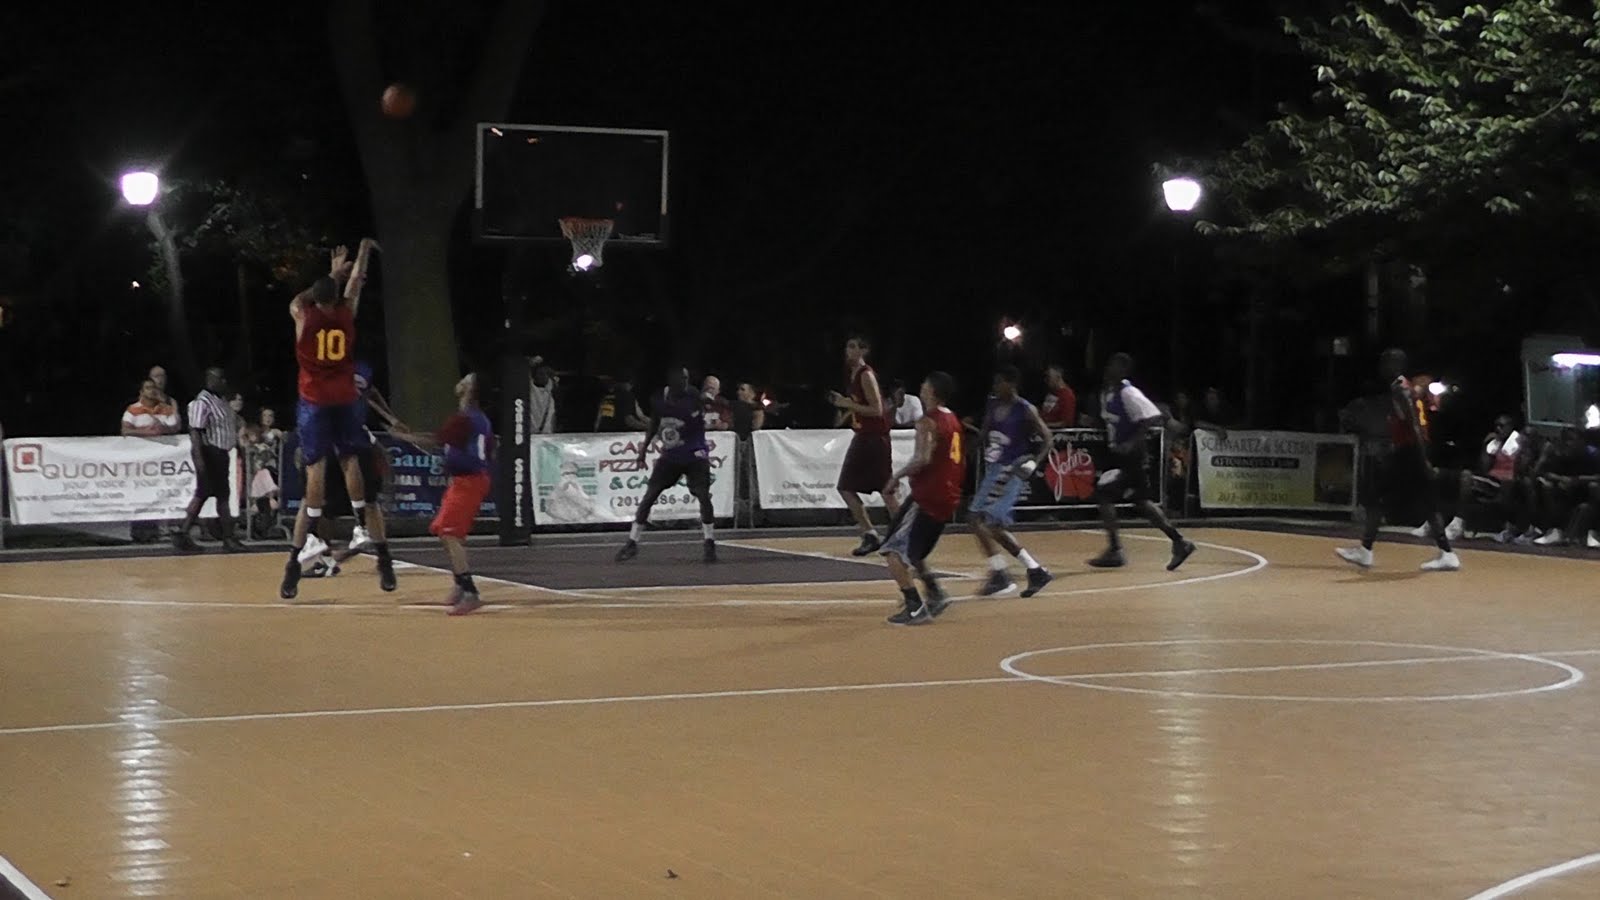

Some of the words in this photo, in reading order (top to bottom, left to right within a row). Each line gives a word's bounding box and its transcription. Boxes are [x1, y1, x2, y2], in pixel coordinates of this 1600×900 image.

[315, 328, 346, 361] 10
[950, 431, 962, 465] 4
[42, 461, 196, 480] QUONTICBA
[610, 496, 640, 509] (201
